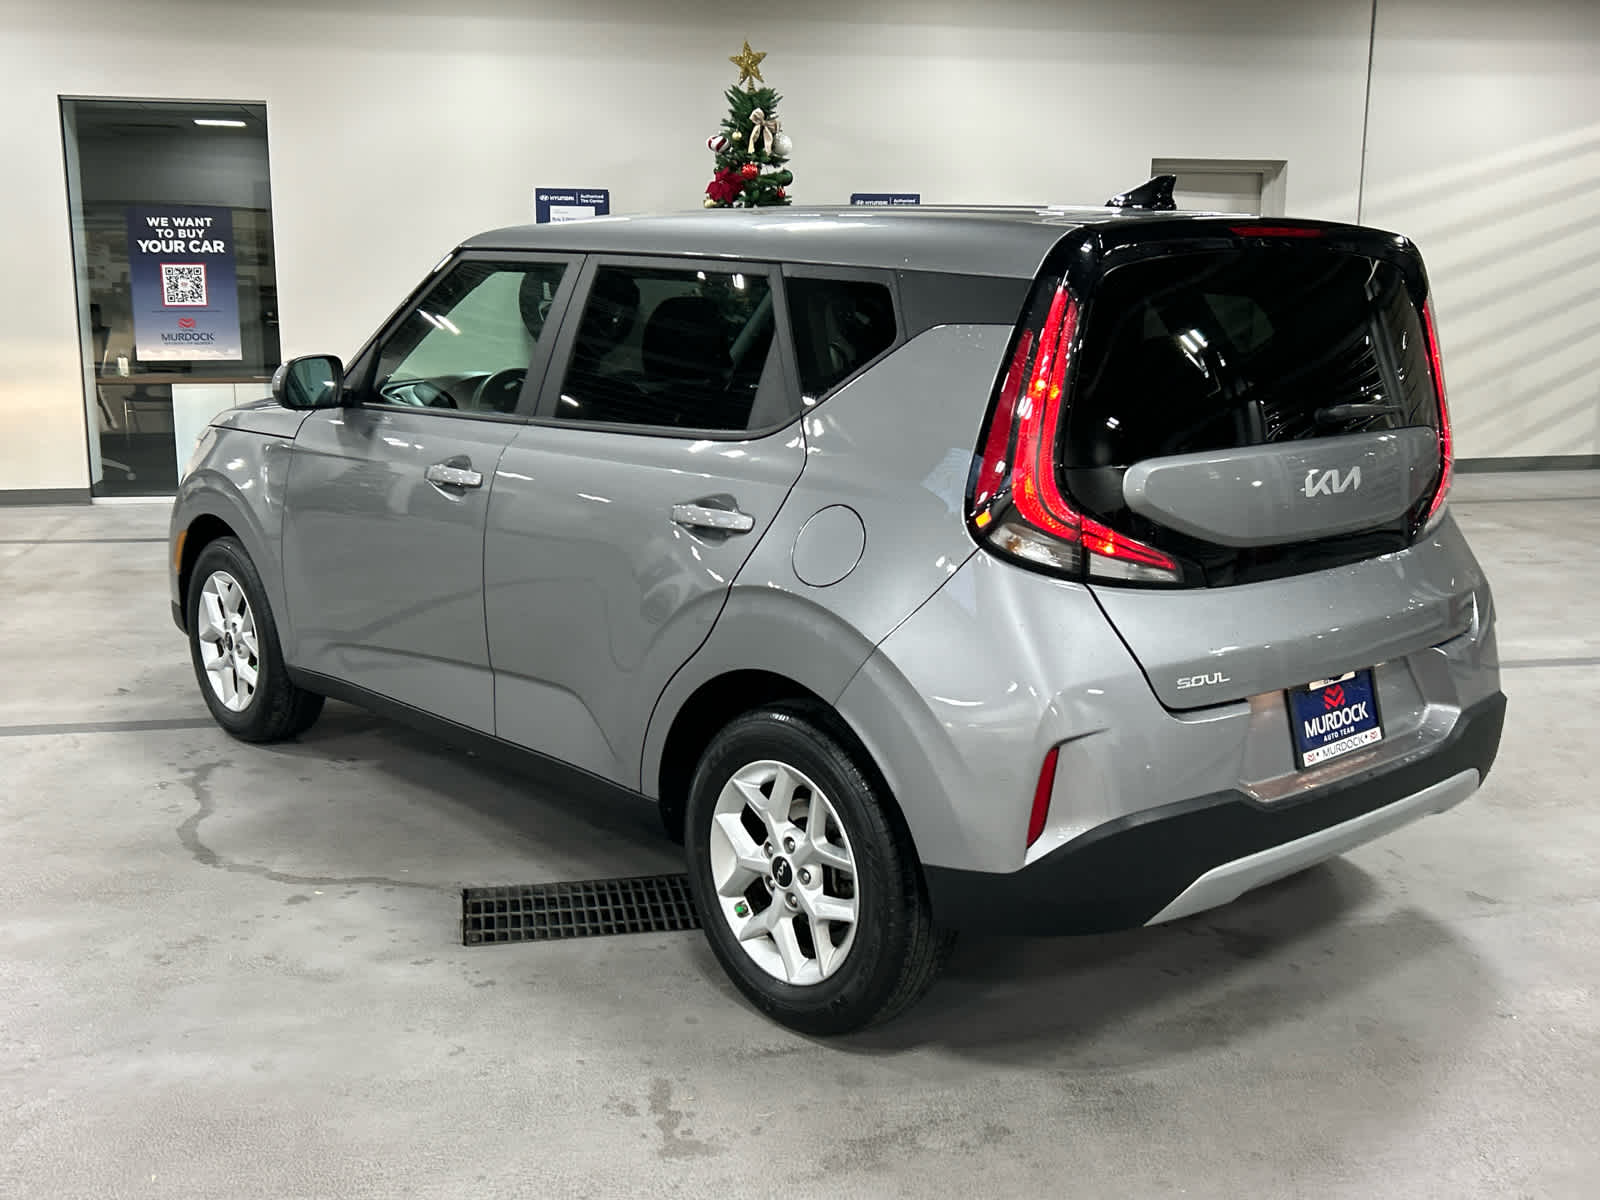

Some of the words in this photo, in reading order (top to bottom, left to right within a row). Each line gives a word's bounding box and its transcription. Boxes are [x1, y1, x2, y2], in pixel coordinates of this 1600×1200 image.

[146, 217, 169, 227] WE
[172, 217, 212, 227] WANT
[155, 229, 174, 238] TO
[178, 229, 205, 238] BUY
[137, 240, 186, 253] YOUR
[188, 240, 225, 253] CAR
[160, 332, 215, 341] MURDOCK
[1304, 466, 1361, 498] KIA
[1177, 672, 1231, 689] SOUL
[1304, 701, 1368, 738] MURDOCK
[1323, 732, 1339, 742] AUTO
[1340, 726, 1355, 736] TEAM
[1321, 734, 1365, 758] MURDOCK
